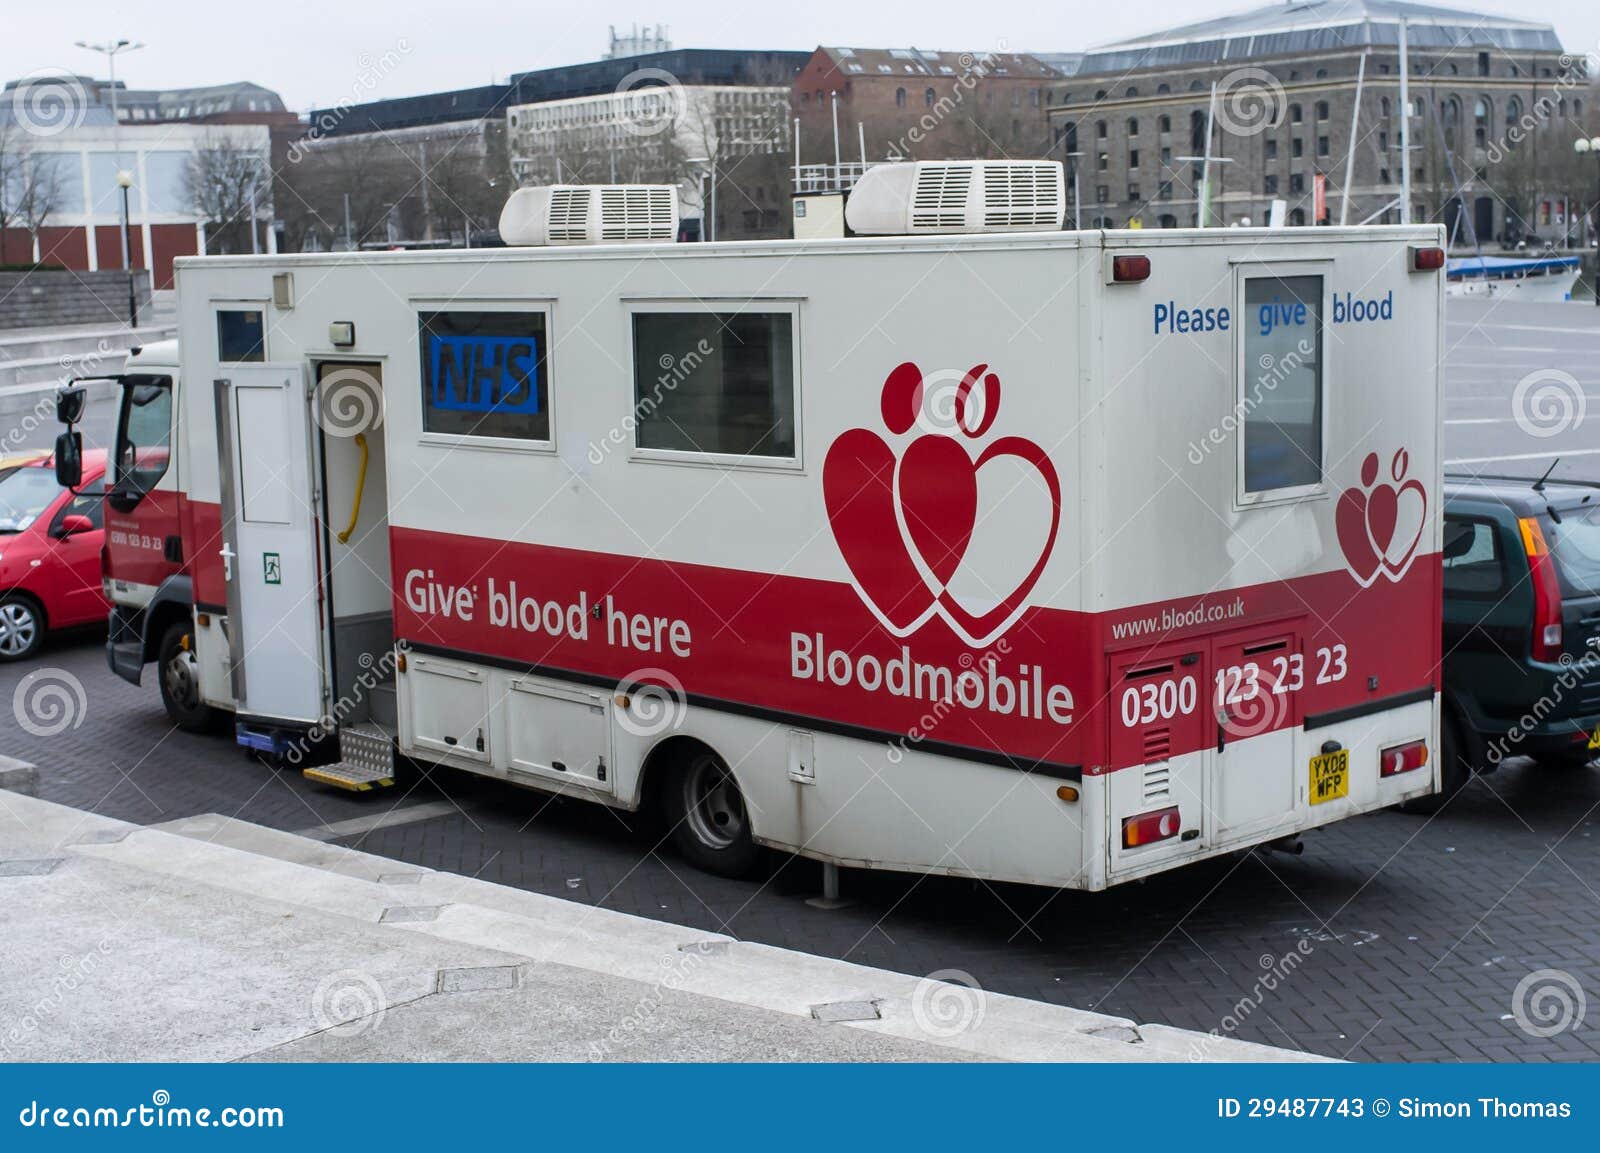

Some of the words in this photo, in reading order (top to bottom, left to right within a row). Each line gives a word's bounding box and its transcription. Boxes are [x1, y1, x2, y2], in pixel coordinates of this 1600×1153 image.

[1153, 300, 1230, 335] Please
[1259, 296, 1307, 336] give
[1333, 290, 1393, 323] blood
[437, 343, 532, 406] NHS
[404, 568, 474, 621] Give
[488, 577, 588, 641] blood
[606, 595, 692, 657] here
[1112, 596, 1245, 640] www.blood.co.uk
[790, 631, 1074, 724] Bloodmobile
[1121, 675, 1197, 728] 0300
[1215, 662, 1259, 706] 123
[1272, 653, 1304, 694] 23
[1316, 644, 1347, 685] 23
[1314, 753, 1346, 778] YX08
[1317, 774, 1342, 797] WFP
